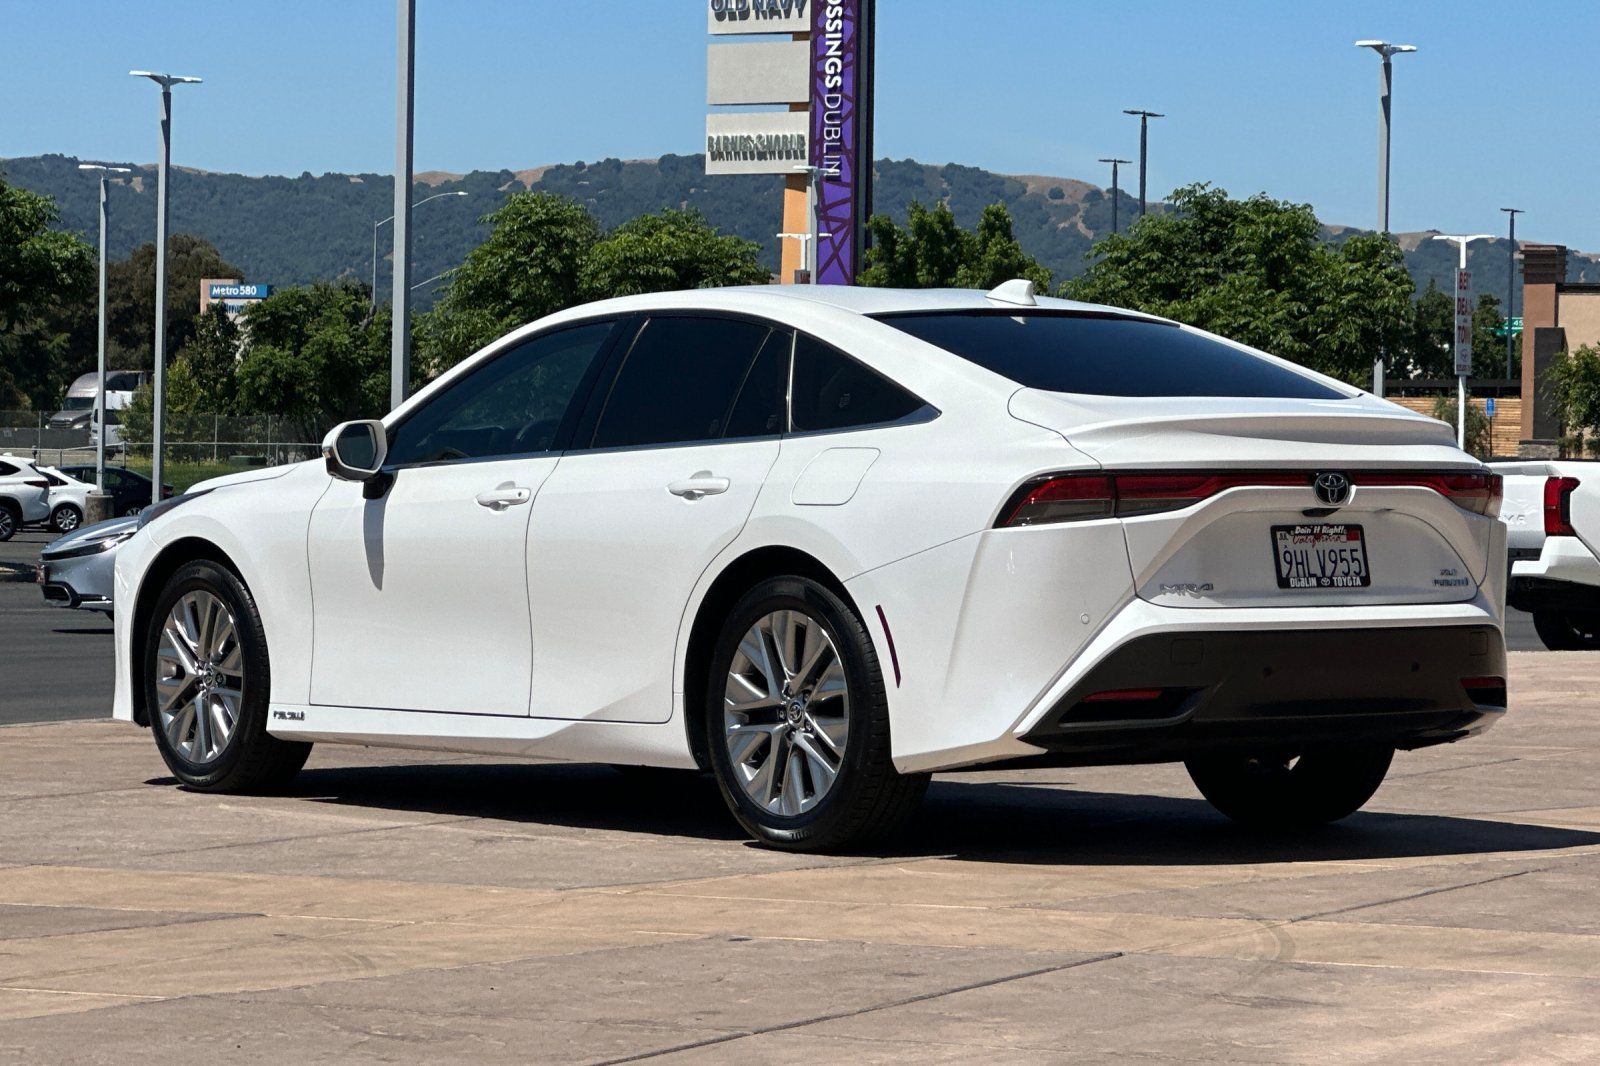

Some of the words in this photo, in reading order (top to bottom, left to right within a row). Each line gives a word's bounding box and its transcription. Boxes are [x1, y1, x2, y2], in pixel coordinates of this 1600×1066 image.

[823, 94, 842, 177] DUBLIN
[212, 285, 239, 295] Metro
[240, 285, 257, 295] 580
[1283, 549, 1362, 577] 9HLV955
[1290, 577, 1317, 588] DUBLIN
[1332, 577, 1361, 587] TOYOTA
